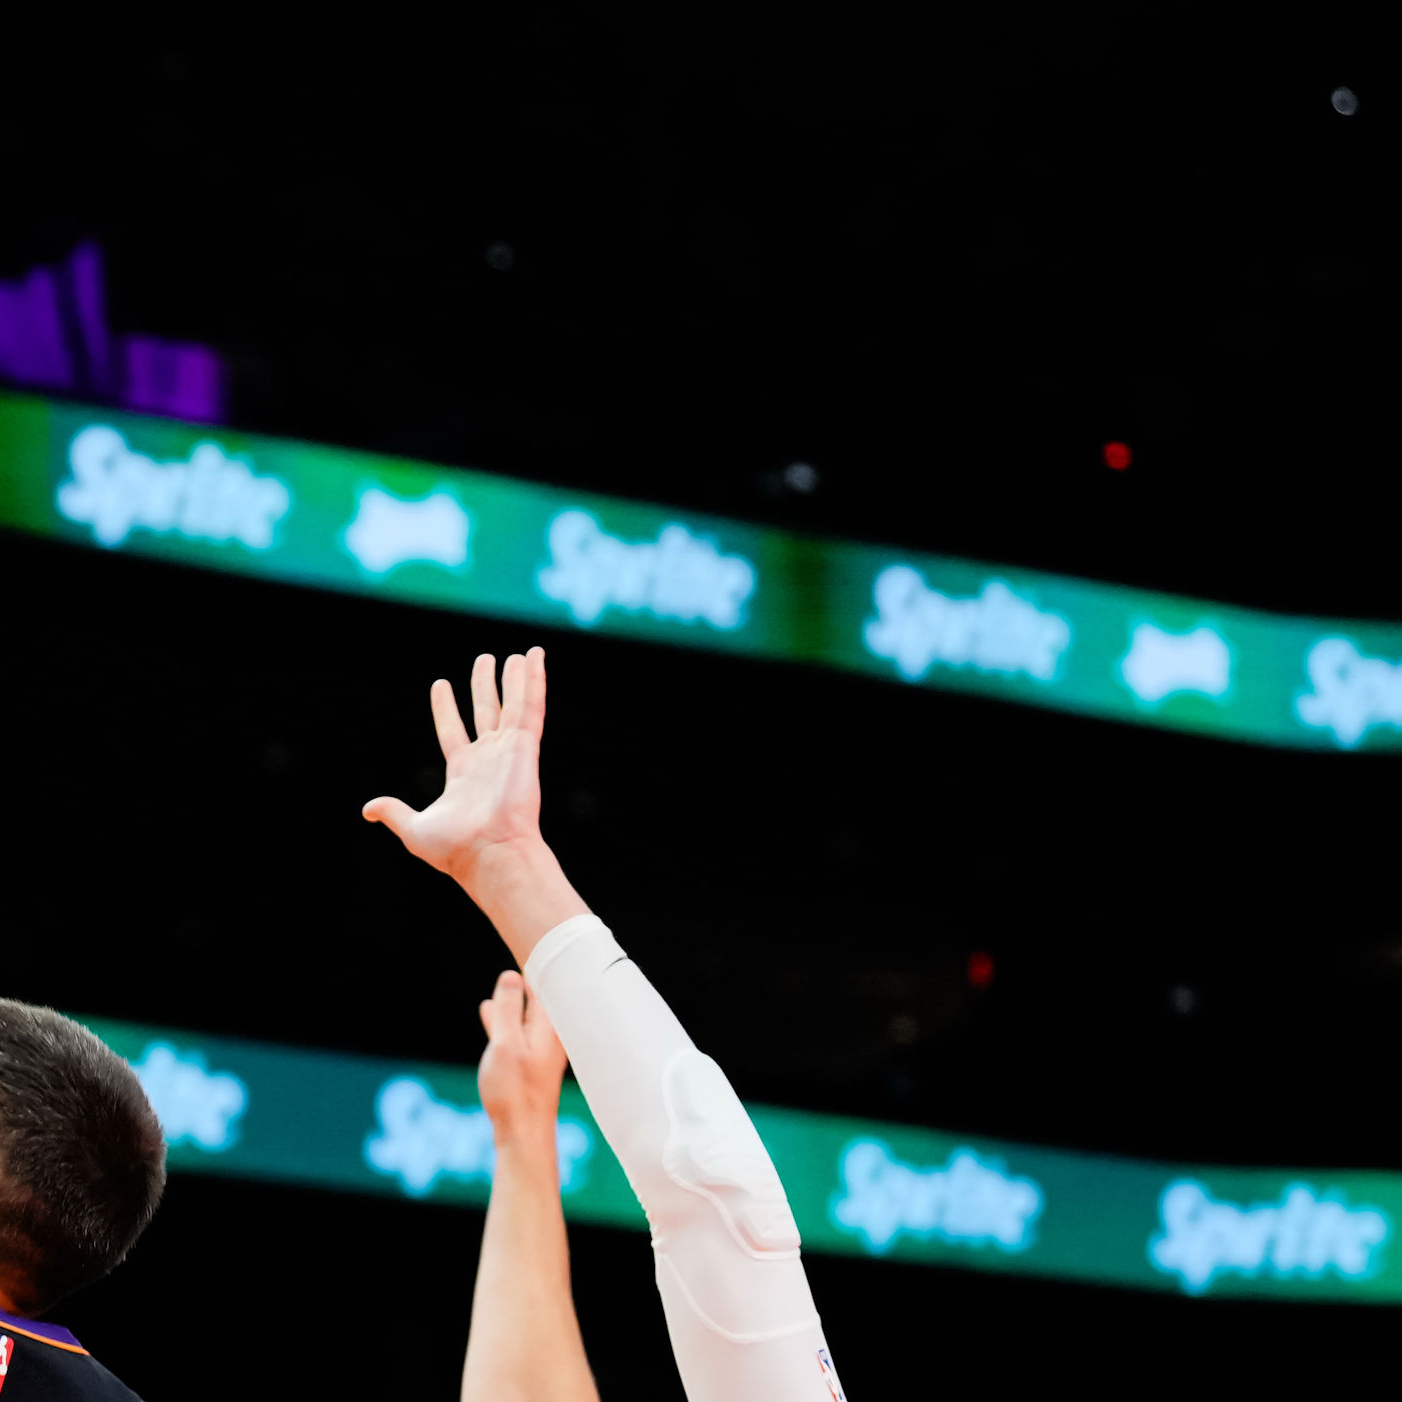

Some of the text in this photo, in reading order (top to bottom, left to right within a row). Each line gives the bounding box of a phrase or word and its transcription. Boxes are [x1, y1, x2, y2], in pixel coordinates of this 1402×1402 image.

[56, 425, 291, 550] Sprite
[536, 508, 758, 632] Sprite
[861, 563, 1072, 684] Sprite
[828, 1136, 1045, 1256] Sprite
[1148, 1178, 1390, 1299] Sprite
